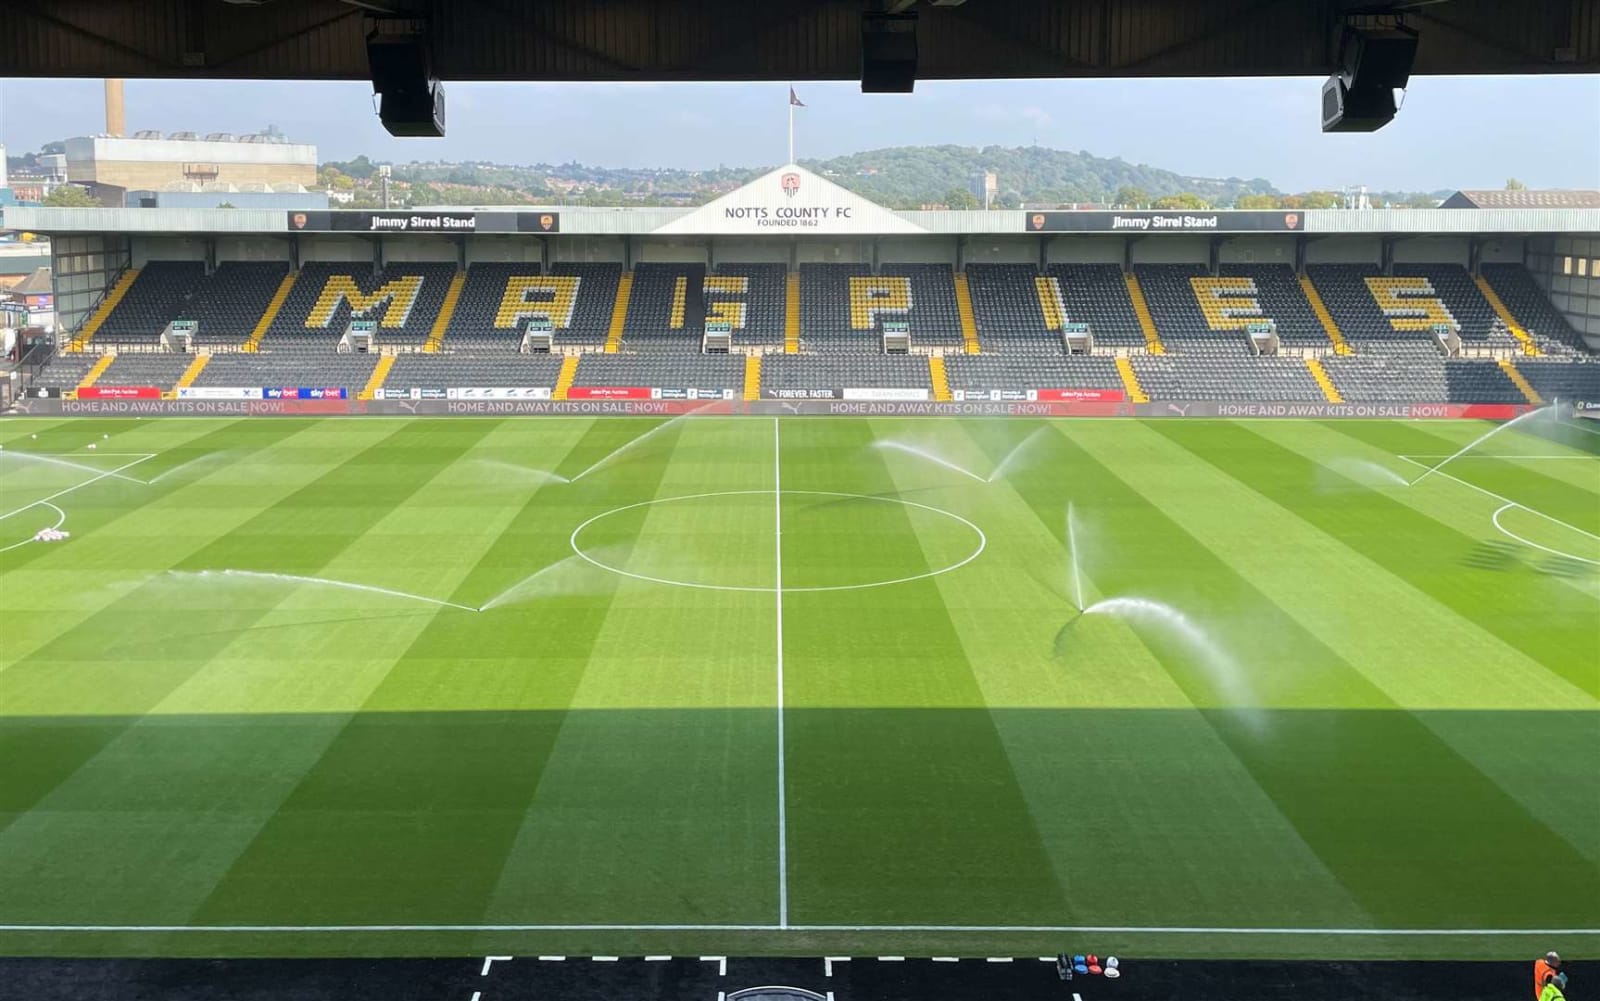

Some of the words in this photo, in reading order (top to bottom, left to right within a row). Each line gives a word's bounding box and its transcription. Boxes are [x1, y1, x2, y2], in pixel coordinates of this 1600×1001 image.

[725, 207, 768, 218] NOTTS
[776, 207, 829, 218] COUNTY
[836, 207, 852, 218] FC
[371, 216, 408, 230] Jimmy
[410, 216, 441, 228] Sirrel
[443, 216, 476, 228] Stand
[757, 219, 798, 227] FOUNDED
[799, 219, 818, 227] 1862
[1113, 215, 1150, 230] Jimmy
[1152, 216, 1183, 228] Sirrel
[1184, 216, 1217, 228] Stand
[267, 390, 282, 399] sky
[283, 389, 297, 397] bet
[310, 390, 323, 399] sky
[325, 389, 340, 397] bet
[779, 390, 808, 398] FOREVER.
[809, 390, 835, 398] FASTER.
[62, 402, 99, 412] HOME
[101, 402, 128, 412] AND
[130, 402, 165, 412] AWAY
[167, 402, 194, 412] KITS
[197, 402, 218, 412] ON
[219, 402, 248, 412] SALE
[250, 402, 285, 412] NOW!
[448, 402, 484, 412] HOME
[487, 402, 513, 412] AND
[516, 402, 549, 412] AWAY
[552, 402, 579, 412] KITS
[581, 402, 599, 412] ON
[601, 402, 631, 412] SALE
[634, 402, 668, 412] NOW!
[830, 403, 868, 413] HOME
[869, 403, 896, 413] AND
[899, 403, 933, 413] AWAY
[934, 403, 961, 413] KITS
[963, 403, 981, 413] ON
[985, 403, 1015, 413] SALE
[1017, 403, 1052, 413] NOW!
[1218, 405, 1256, 416] HOME
[1258, 405, 1286, 416] AND
[1288, 405, 1324, 416] AWAY
[1326, 405, 1353, 416] KITS
[1356, 405, 1376, 416] ON
[1378, 405, 1409, 416] SALE
[1411, 405, 1448, 416] NOW!
